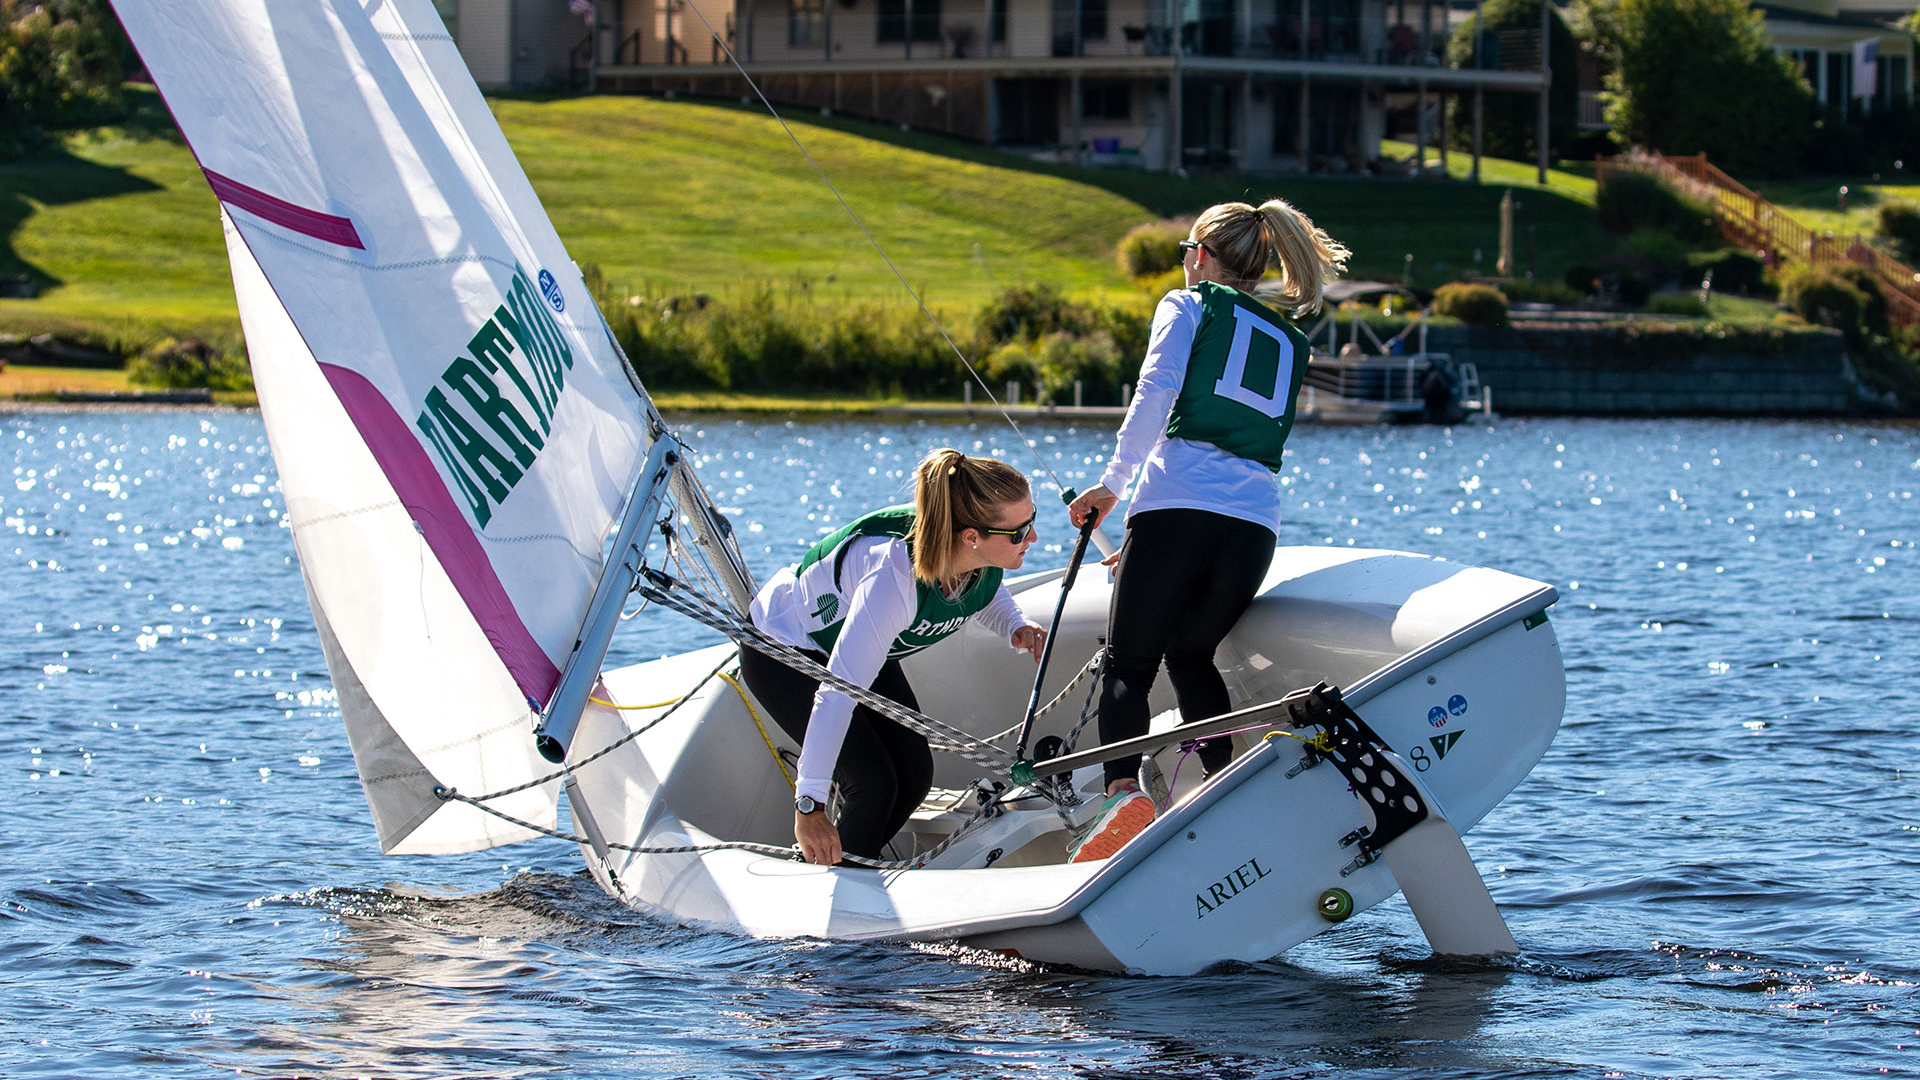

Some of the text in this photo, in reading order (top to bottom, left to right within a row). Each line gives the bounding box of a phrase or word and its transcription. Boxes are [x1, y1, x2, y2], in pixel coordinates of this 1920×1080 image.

[1214, 304, 1294, 419] D
[1410, 745, 1431, 772] 8
[1196, 857, 1272, 919] ARIEL
